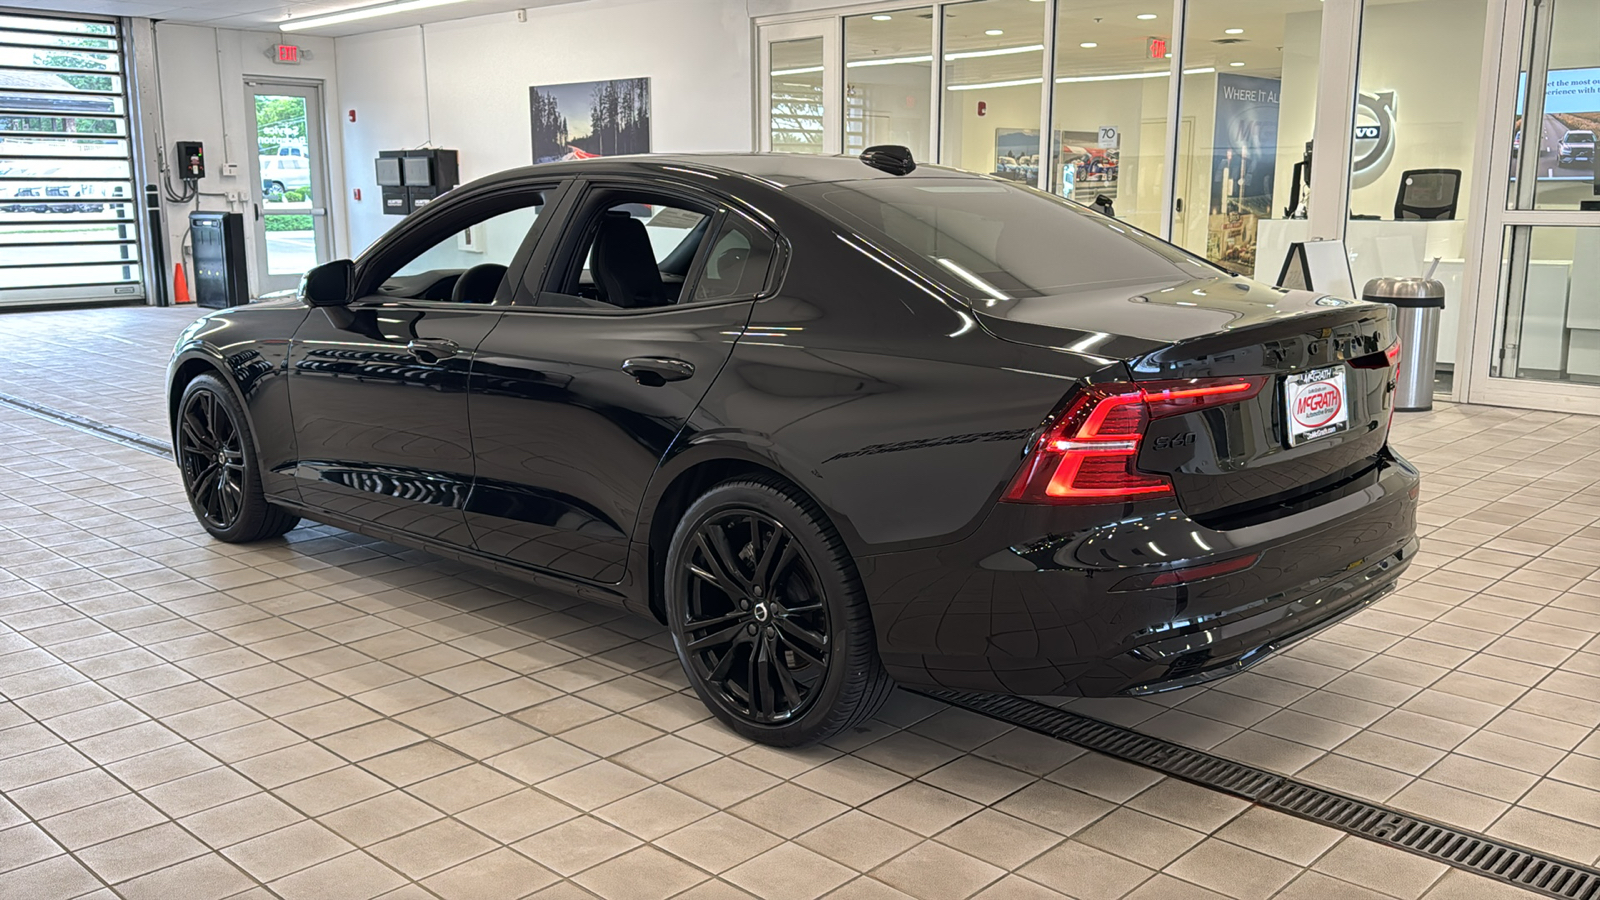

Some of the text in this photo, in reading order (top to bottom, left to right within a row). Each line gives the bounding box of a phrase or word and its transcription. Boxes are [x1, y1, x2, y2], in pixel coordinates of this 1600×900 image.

[279, 45, 297, 61] EXIT
[1556, 79, 1570, 87] the
[1223, 86, 1257, 101] WHERE
[1577, 86, 1596, 94] with
[1101, 128, 1116, 139] 70
[1305, 407, 1334, 419] Automotive Group
[1152, 431, 1197, 451] S60
